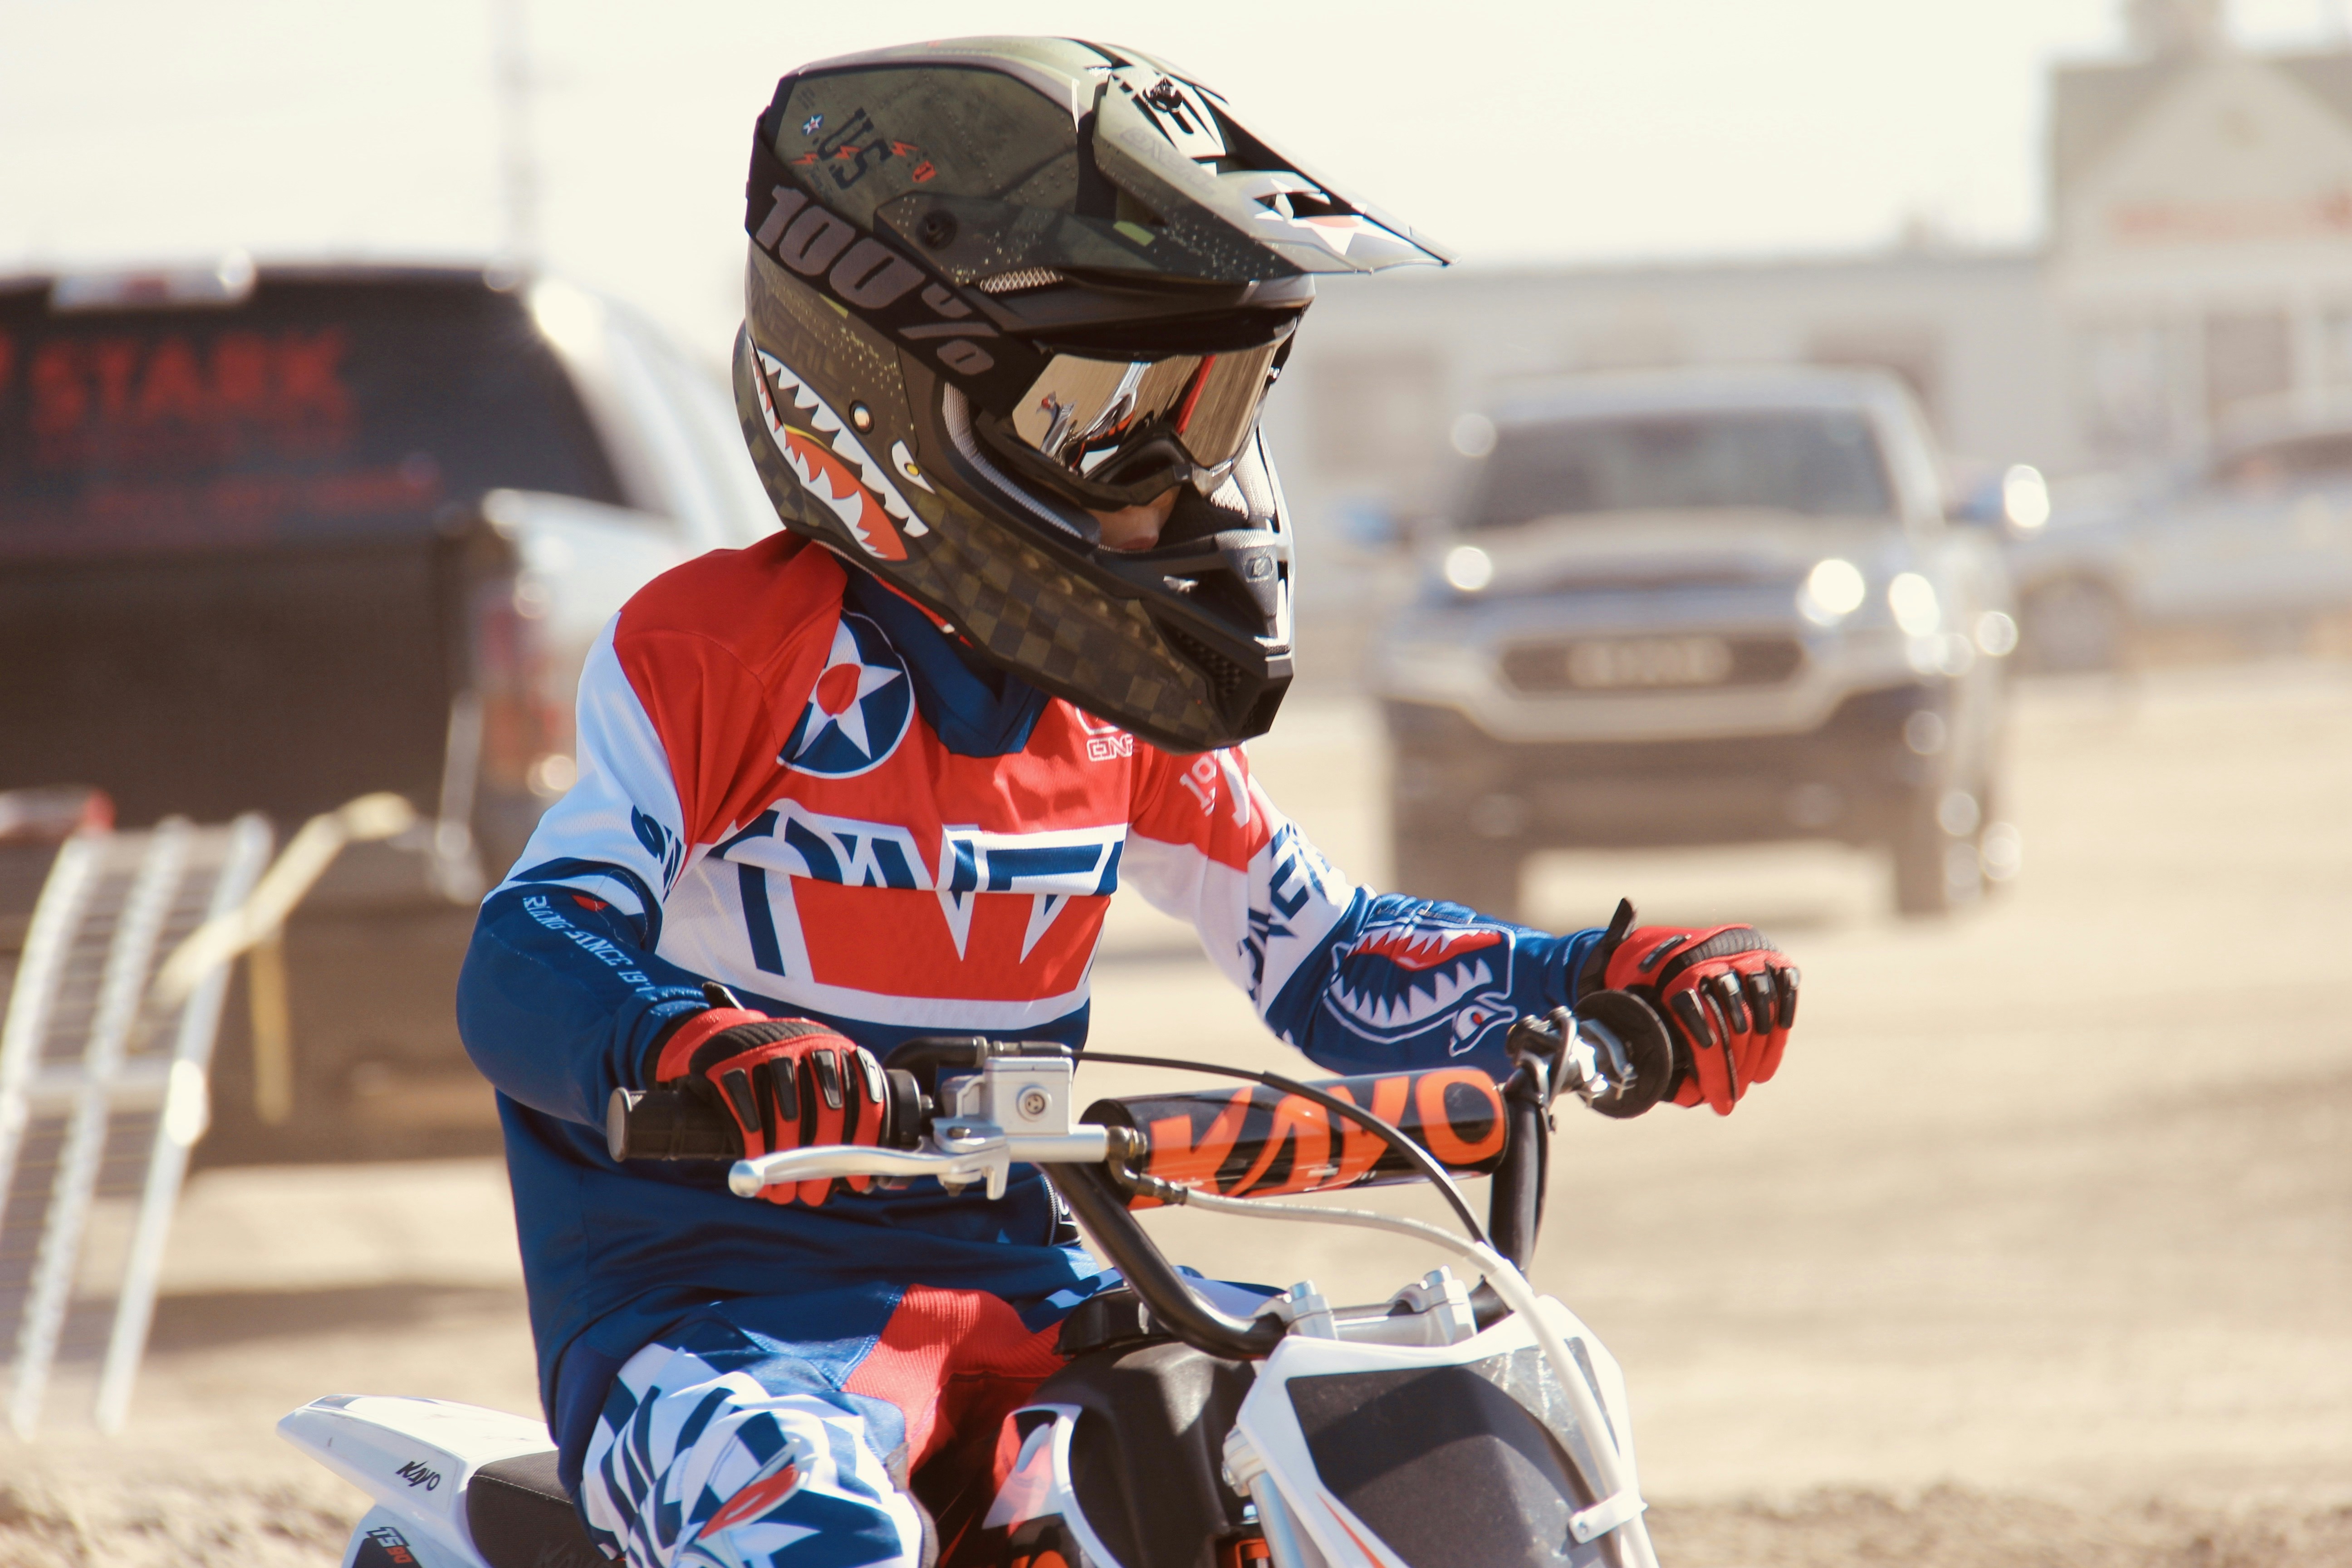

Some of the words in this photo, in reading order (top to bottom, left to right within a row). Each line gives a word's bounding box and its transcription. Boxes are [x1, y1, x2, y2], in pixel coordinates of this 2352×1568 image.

[755, 184, 1000, 376] 100%
[563, 930, 634, 966] SINCE
[1127, 1066, 1505, 1210] KAYO
[396, 1460, 441, 1491] KAYO
